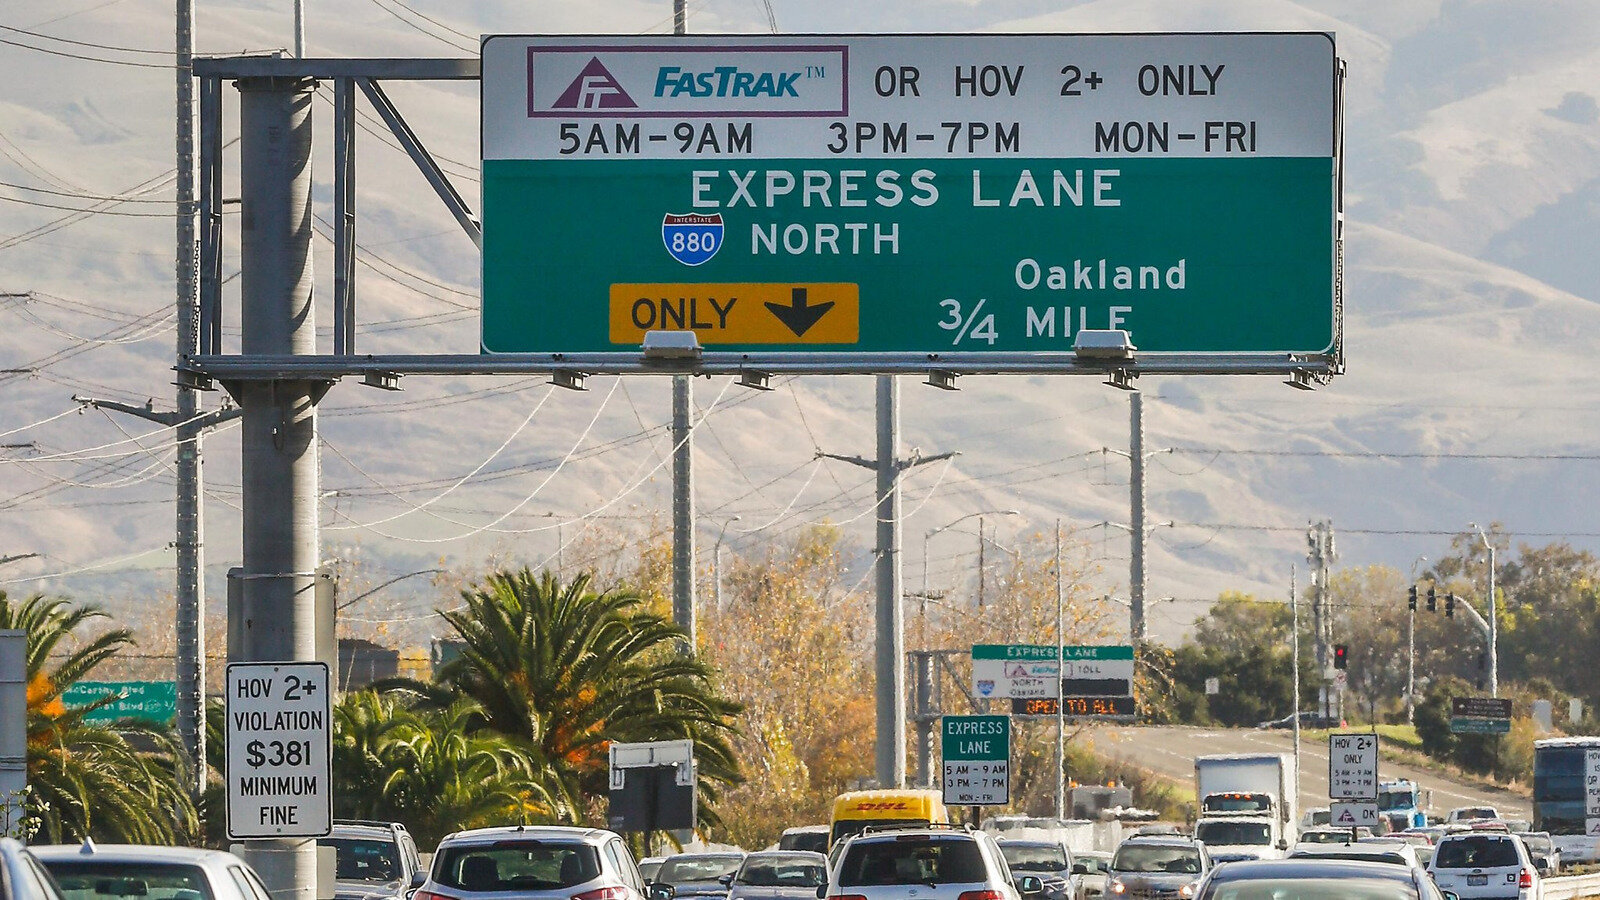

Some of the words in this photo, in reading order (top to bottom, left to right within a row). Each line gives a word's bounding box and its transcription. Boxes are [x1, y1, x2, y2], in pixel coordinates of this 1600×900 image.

[875, 66, 920, 97] OR
[955, 65, 1025, 97] HOV
[1061, 65, 1103, 97] 2+
[1138, 64, 1226, 96] ONLY
[692, 169, 939, 208] EXPRESS
[973, 169, 1122, 207] LANE
[672, 232, 715, 252] 880
[752, 223, 900, 255] NORTH
[1015, 259, 1187, 290] Oakland
[632, 298, 737, 330] ONLY
[1007, 646, 1060, 657] EXPRESS
[1066, 648, 1097, 658] LANE
[1078, 665, 1101, 674] TOLL
[237, 678, 272, 699] HOV
[284, 675, 316, 700] 2+
[1012, 679, 1044, 687] NORTH
[1026, 700, 1059, 714] OPEN
[1067, 700, 1087, 714] TO
[1093, 700, 1117, 714] ALL
[234, 711, 323, 732] VIOLATION
[948, 721, 1003, 735] EXPRESS
[960, 741, 991, 754] LANE
[1334, 738, 1350, 748] HOV
[1357, 737, 1373, 750] 2+
[246, 739, 311, 769] $381
[1344, 754, 1363, 763] ONLY
[946, 765, 952, 775] 5
[956, 765, 969, 774] AM
[982, 765, 989, 774] 9
[992, 765, 1006, 774] AM
[240, 776, 317, 797] MINIMUM
[947, 779, 954, 788] 3
[957, 779, 970, 787] PM
[982, 779, 988, 787] 7
[992, 779, 1005, 787] PM
[856, 802, 908, 811] DHL
[260, 806, 298, 826] FINE
[1362, 809, 1375, 819] OK
